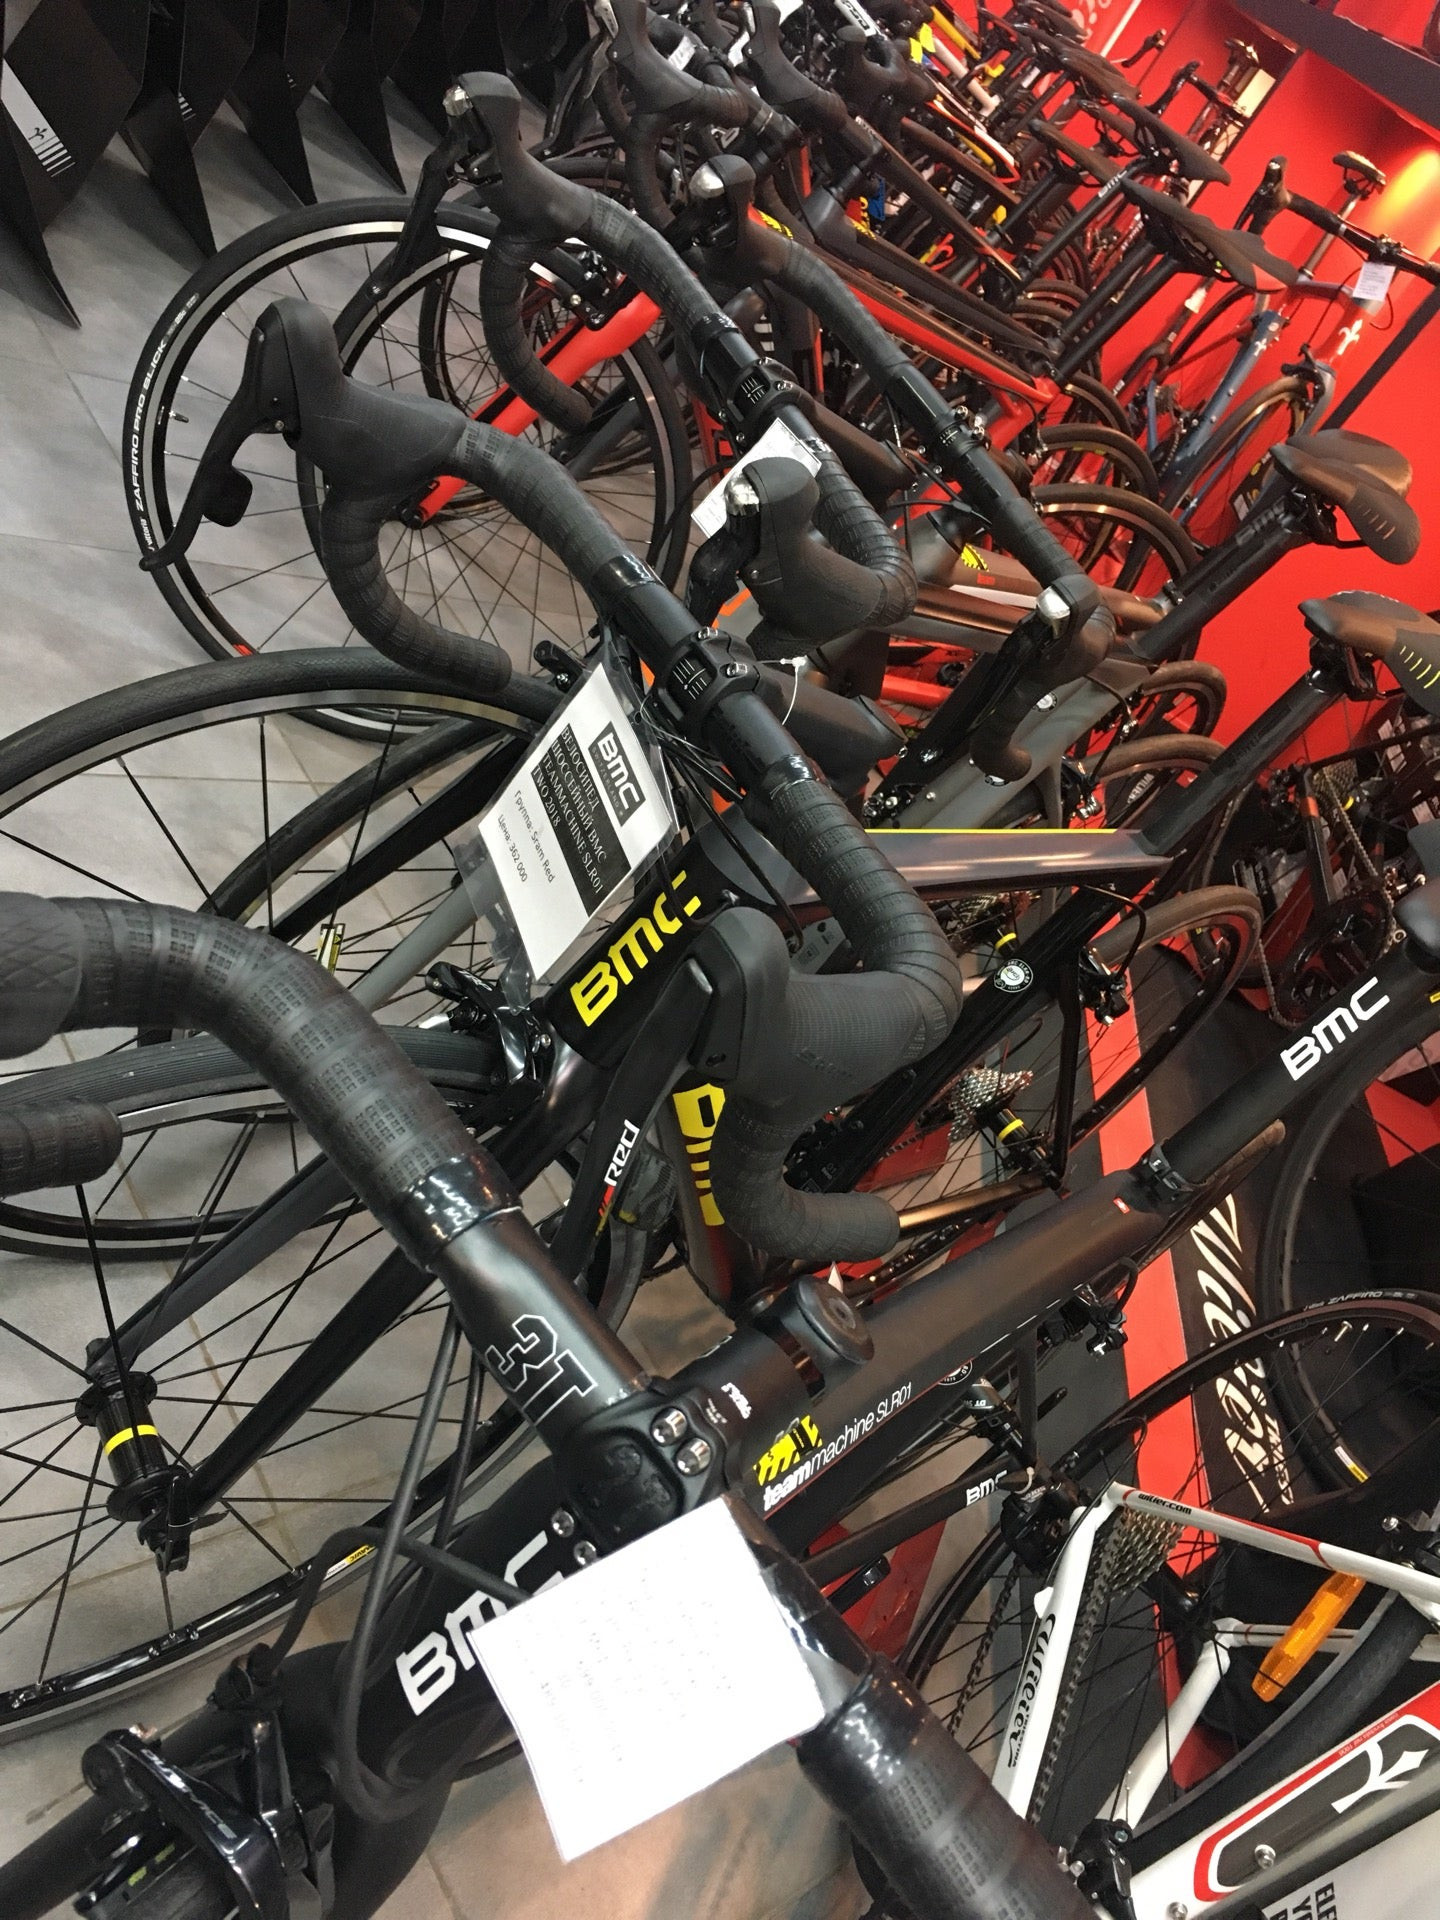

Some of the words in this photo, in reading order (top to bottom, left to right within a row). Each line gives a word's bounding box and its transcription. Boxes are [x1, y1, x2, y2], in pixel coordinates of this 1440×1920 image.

[142, 341, 168, 391] SLICK
[133, 393, 146, 433] PRO
[131, 434, 145, 512] ZAFFIRO
[531, 764, 551, 804] TWO
[544, 799, 561, 828] 2018
[550, 738, 592, 834] ШОССЕЙНЫЙ
[560, 724, 600, 813] ВЕЛОСИПЕД
[598, 732, 640, 811] BMC
[530, 831, 547, 868] Sram
[542, 860, 556, 883] Red
[541, 753, 585, 858] TEAMMACHINE
[581, 847, 603, 894] SLR01
[508, 837, 522, 866] 362
[515, 861, 529, 883] 000
[570, 870, 702, 1028] BMC
[1280, 976, 1390, 1081] BMC
[1327, 1289, 1384, 1306] ZAFFIRO
[484, 1313, 599, 1427] 3T
[875, 1381, 914, 1425] SLR01
[1137, 1493, 1193, 1516] wilier.com
